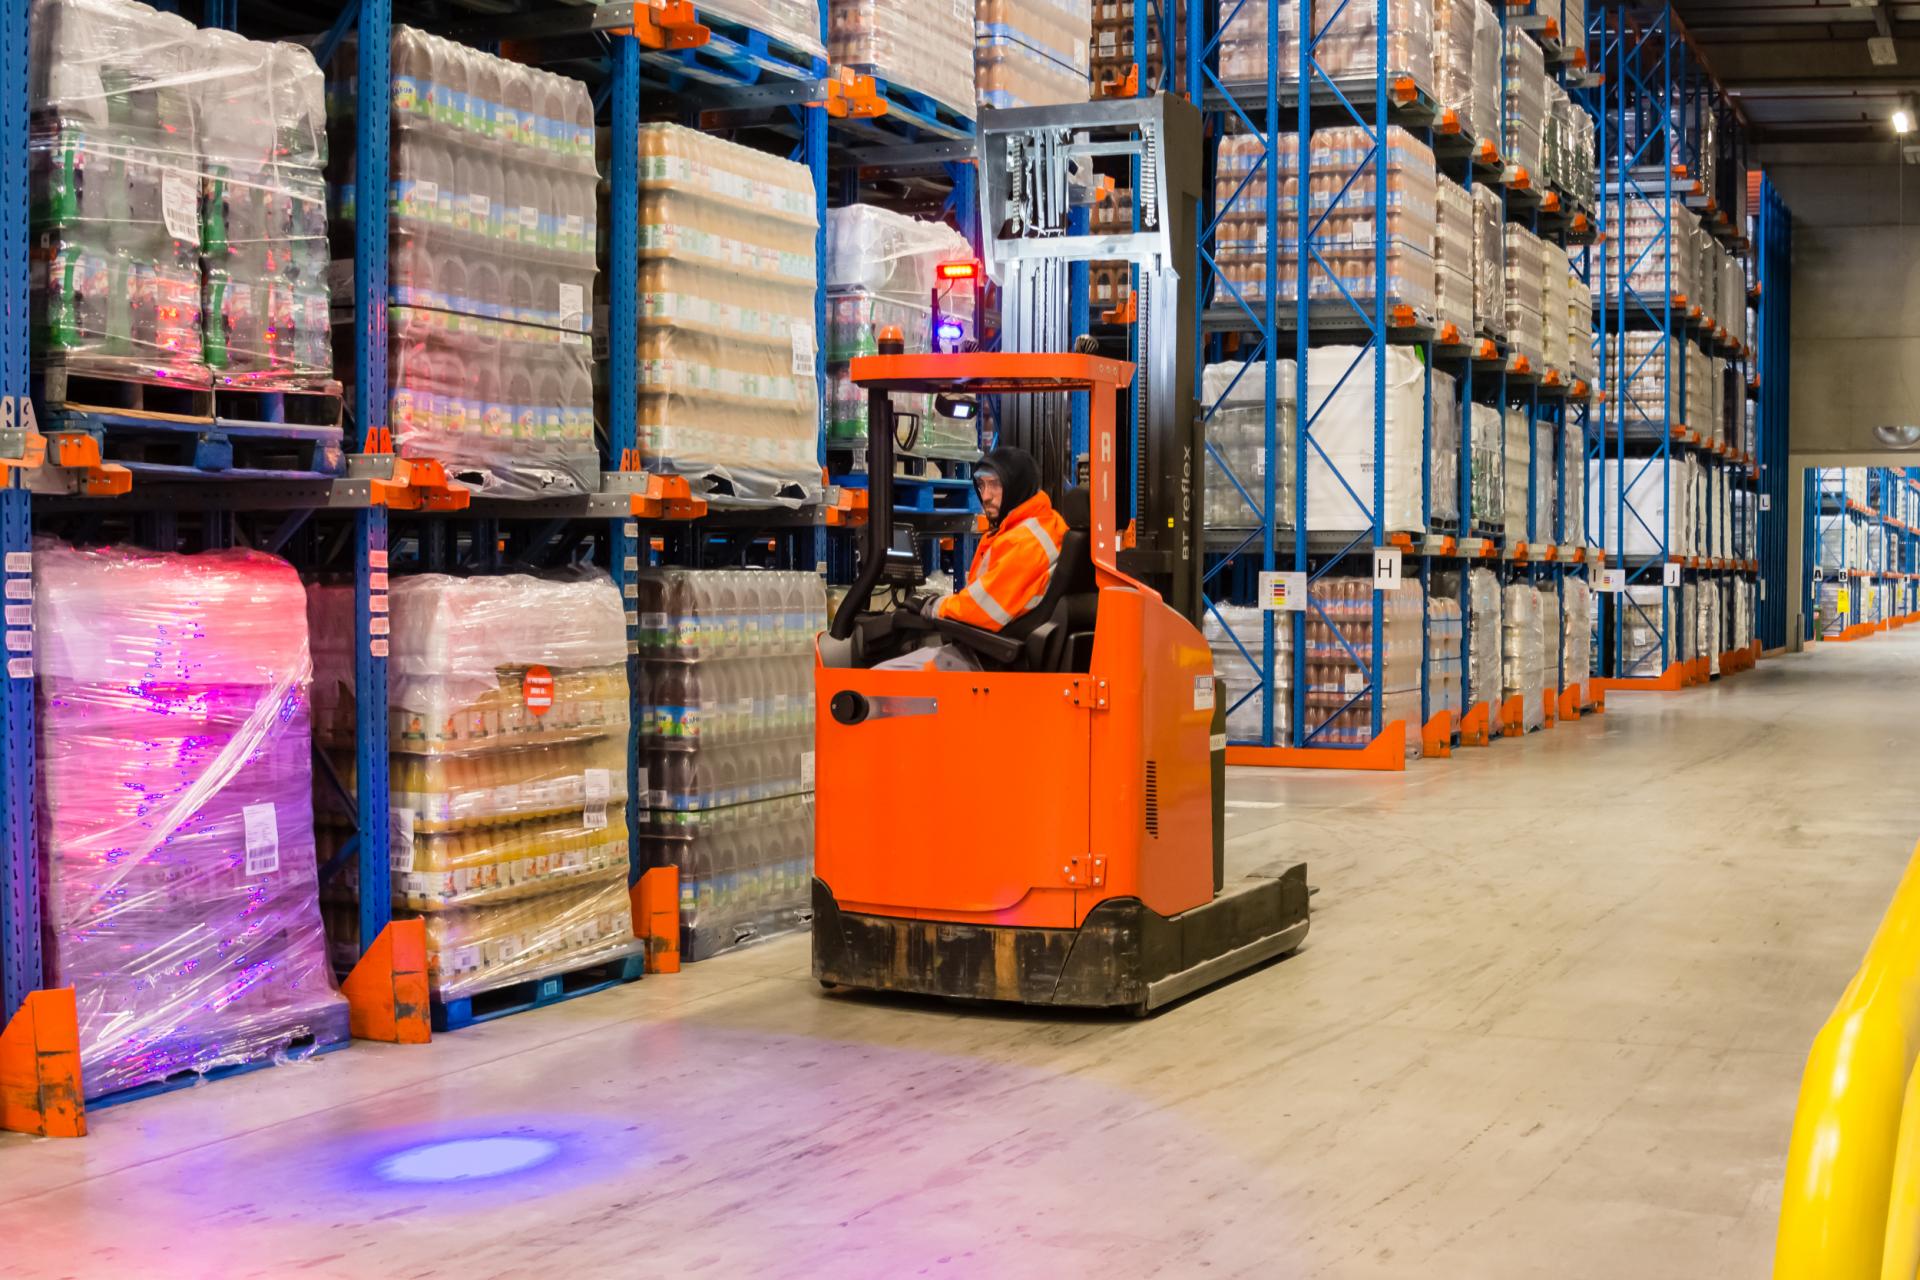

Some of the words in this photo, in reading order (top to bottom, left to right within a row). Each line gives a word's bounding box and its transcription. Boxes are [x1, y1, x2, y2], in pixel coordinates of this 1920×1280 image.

[1181, 445, 1191, 522] reflex
[1762, 497, 1769, 508] L
[1182, 530, 1190, 561] BT
[1378, 558, 1392, 579] H
[1814, 569, 1822, 580] A
[1839, 571, 1847, 580] B
[1669, 570, 1675, 584] J
